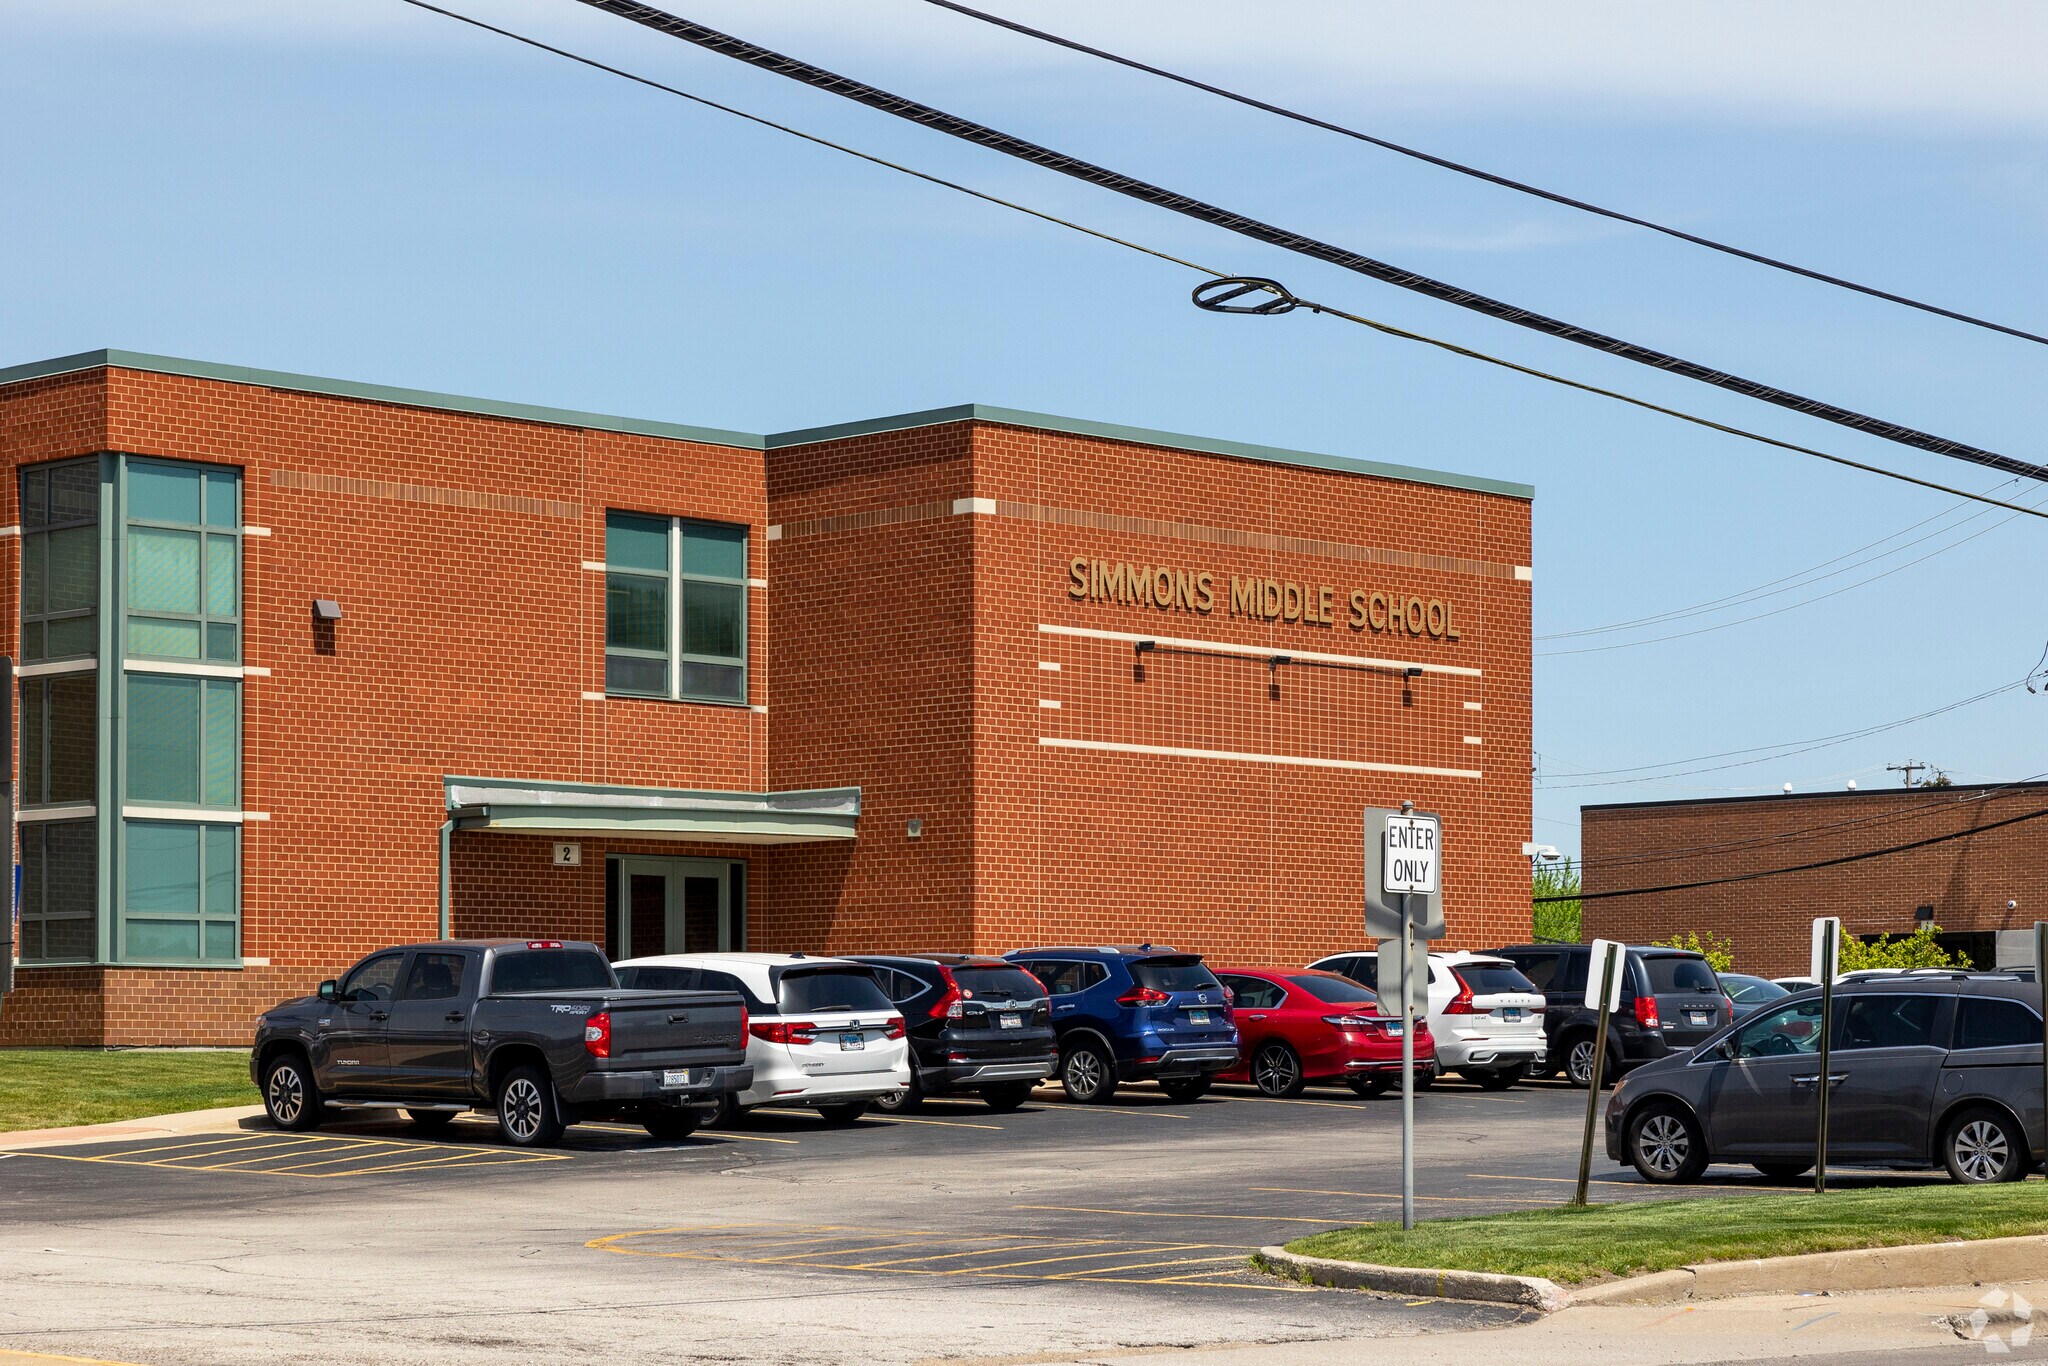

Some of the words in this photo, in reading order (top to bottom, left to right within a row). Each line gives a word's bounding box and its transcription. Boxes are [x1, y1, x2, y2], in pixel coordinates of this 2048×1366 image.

[1068, 556, 1214, 611] SIMMONS
[1230, 575, 1334, 624] MIDDLE
[1349, 589, 1461, 638] SCHOOL
[1389, 825, 1434, 850] ENTER
[563, 846, 571, 862] 2
[1393, 858, 1429, 883] ONLY
[694, 1034, 739, 1045] TUNDRA
